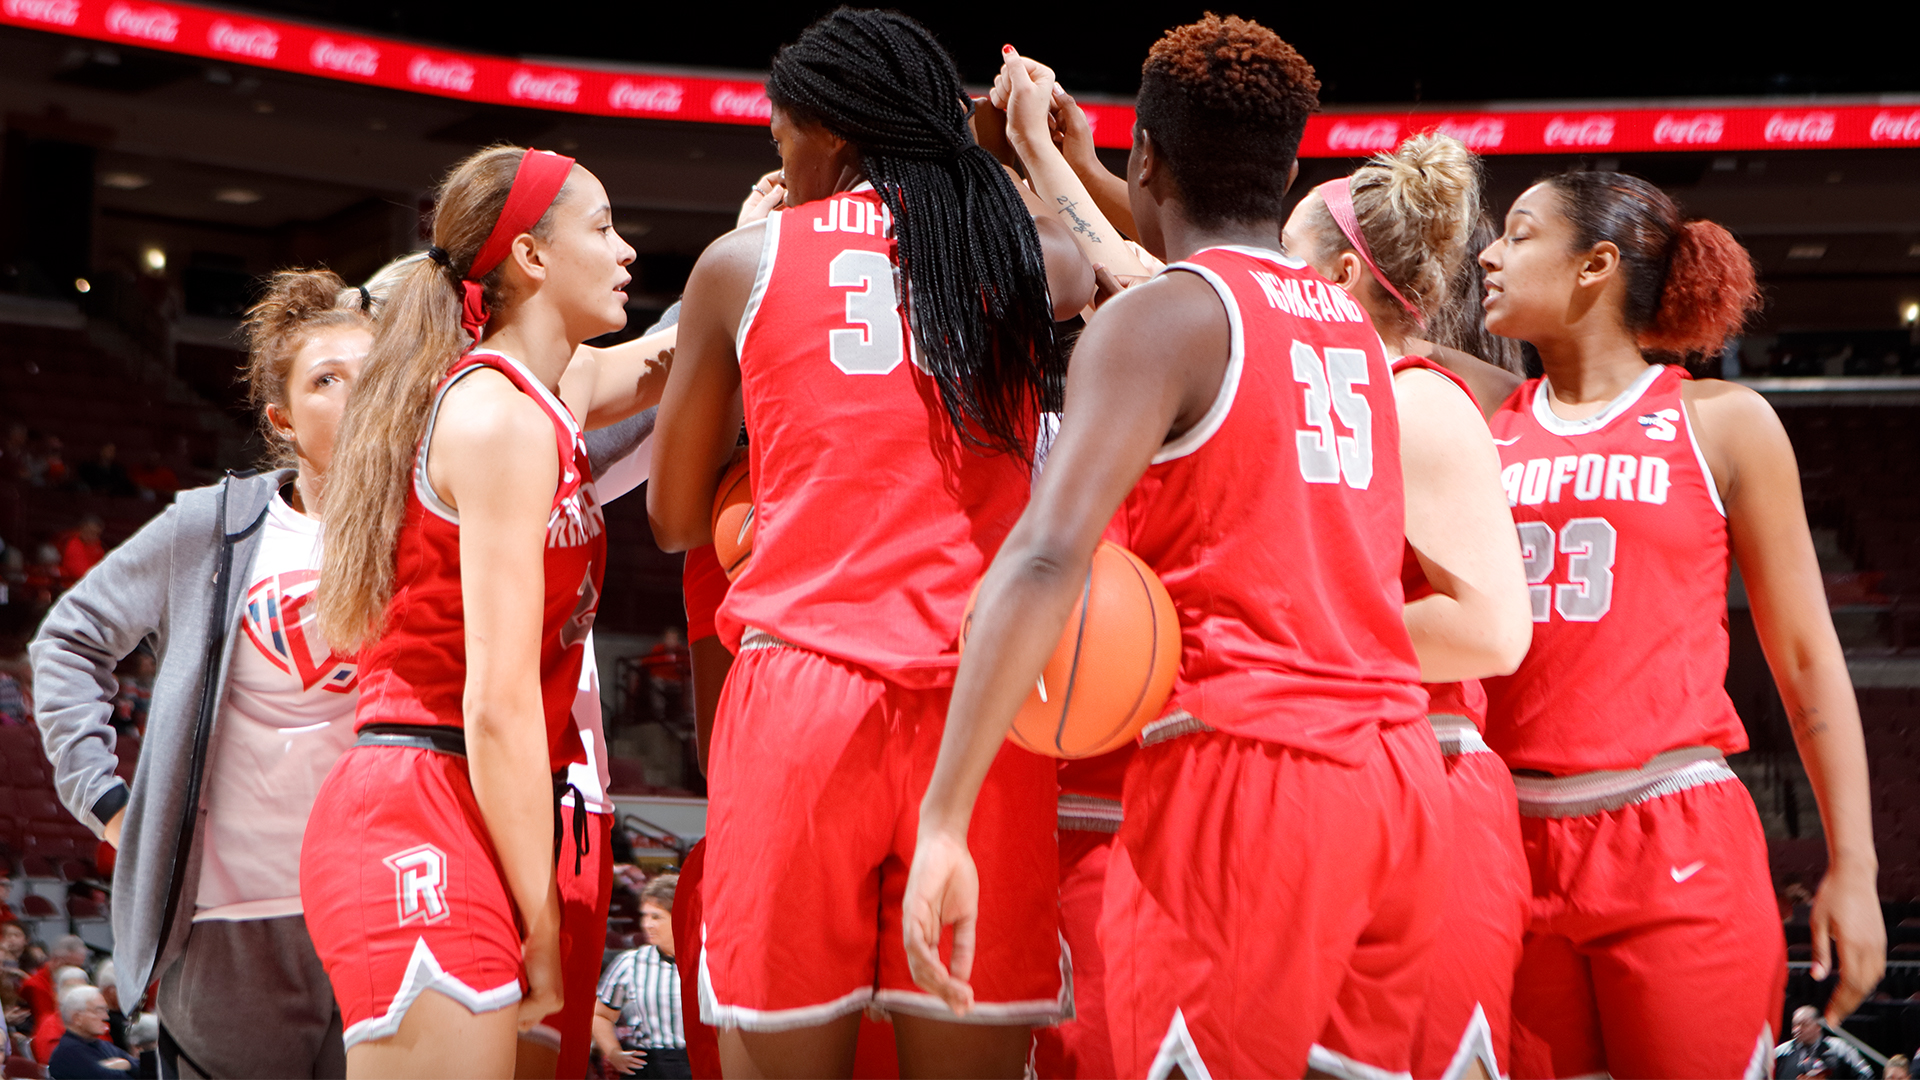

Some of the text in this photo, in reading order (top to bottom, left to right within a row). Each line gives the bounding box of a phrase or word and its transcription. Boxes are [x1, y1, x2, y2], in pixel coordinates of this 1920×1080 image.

[813, 197, 898, 240] JOH
[829, 249, 938, 376] 3
[1290, 339, 1374, 490] 35
[1500, 453, 1672, 507] ADFORD
[1516, 517, 1617, 623] 23
[383, 843, 450, 928] R
